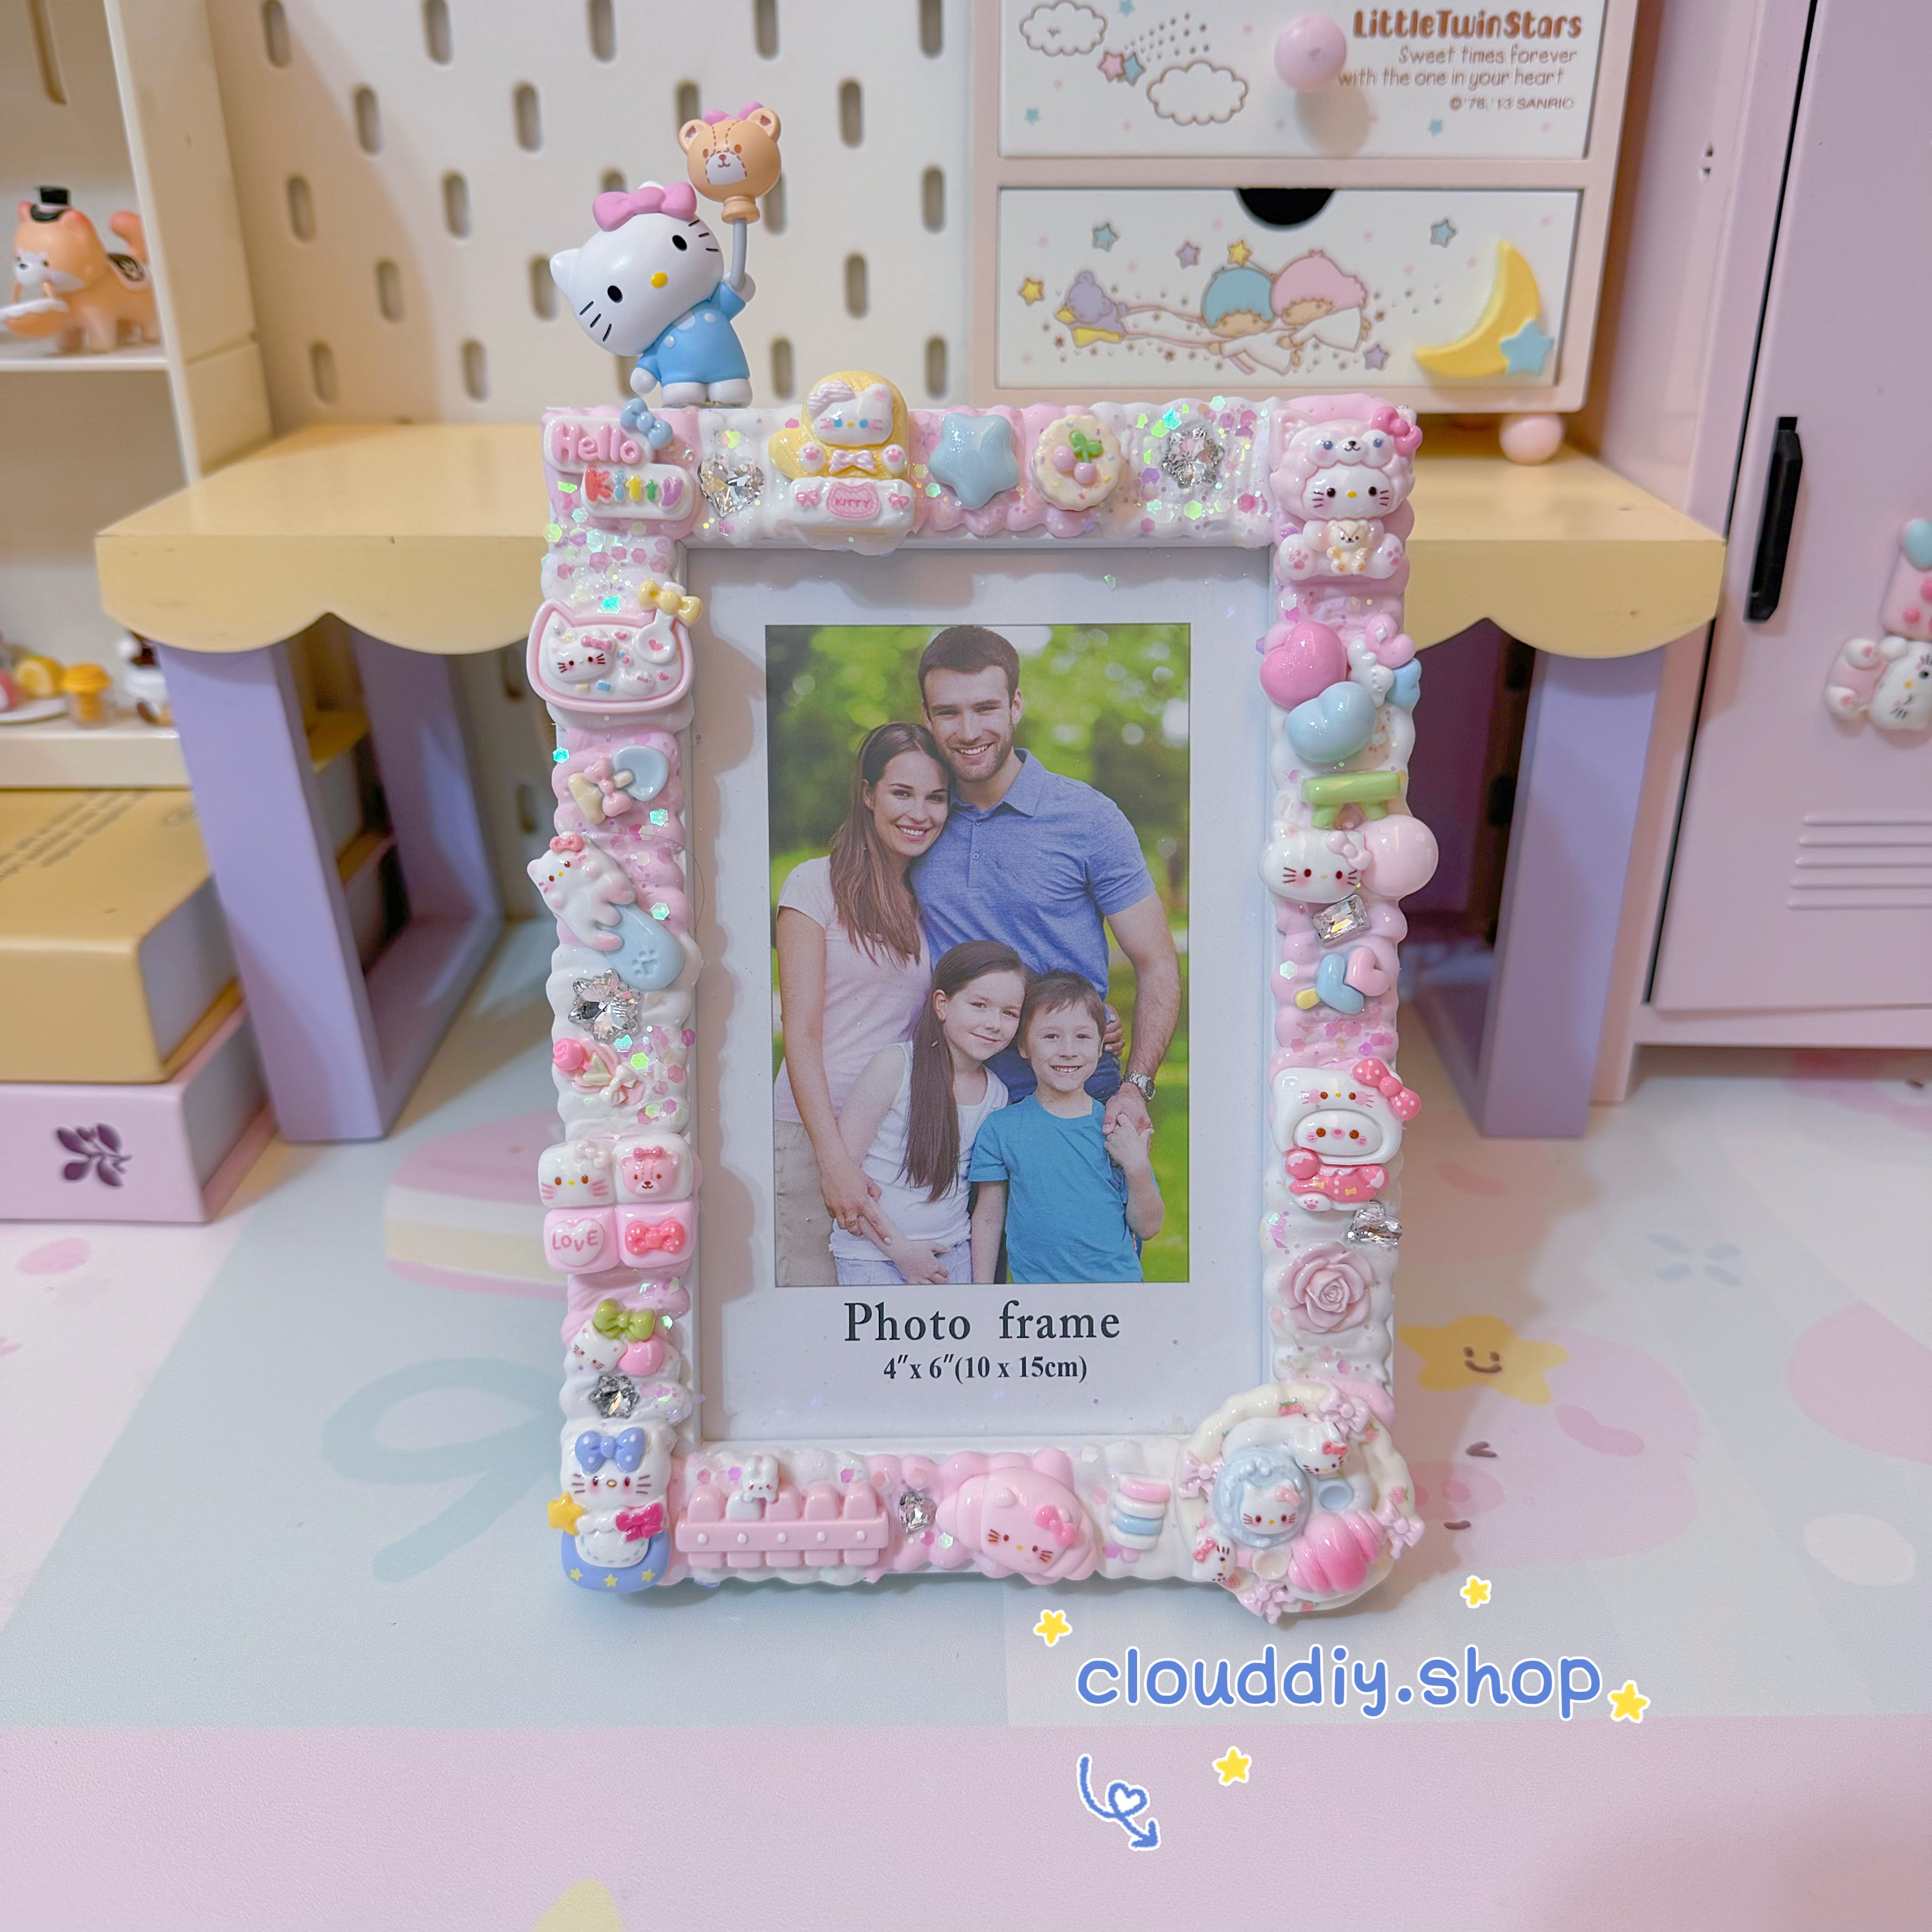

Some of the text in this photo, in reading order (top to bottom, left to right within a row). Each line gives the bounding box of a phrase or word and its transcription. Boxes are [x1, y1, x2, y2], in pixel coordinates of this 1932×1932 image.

[1399, 44, 1577, 64] Sweet times forever
[1338, 67, 1564, 91] with the one in your heart
[1516, 97, 1573, 109] SANRIO
[552, 423, 641, 464] Hello
[585, 465, 684, 507] Kitty
[835, 497, 871, 509] KITTY
[552, 1229, 599, 1252] LOVE
[844, 1299, 1120, 1341] Photo frame
